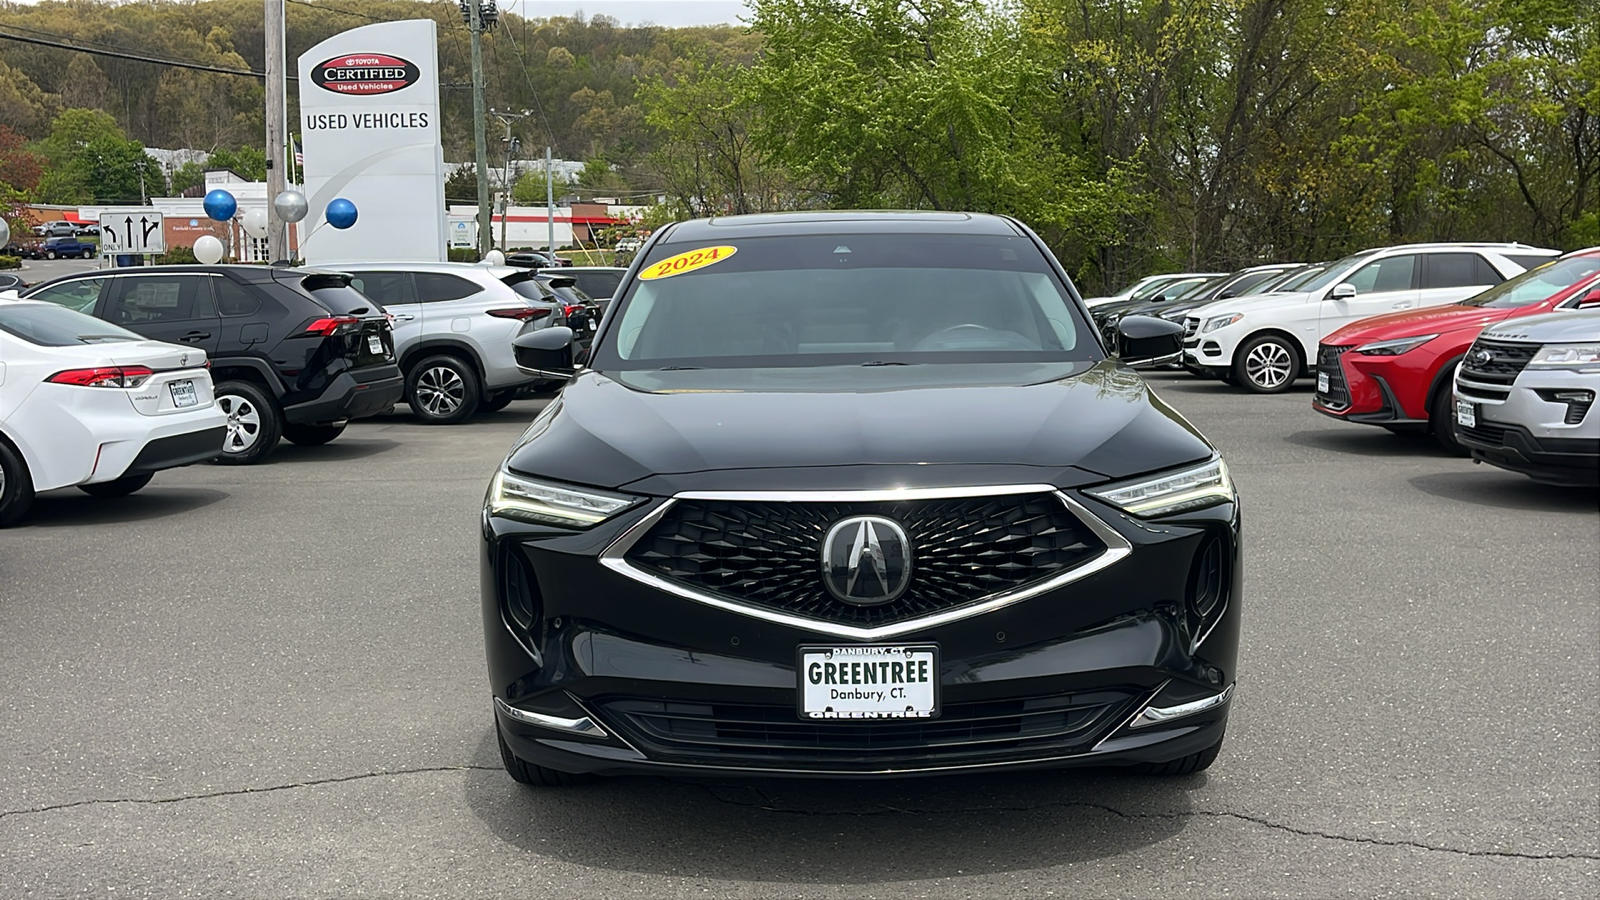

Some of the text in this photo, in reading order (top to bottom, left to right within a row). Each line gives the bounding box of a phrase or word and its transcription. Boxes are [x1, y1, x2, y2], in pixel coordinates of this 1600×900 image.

[337, 83, 358, 91] Used
[307, 112, 429, 130] USED VEHICLES
[657, 248, 721, 277] 2024
[833, 647, 888, 656] DANBURY,
[808, 660, 928, 685] GREENTREE
[830, 687, 907, 702] Danbury, CT.
[809, 710, 931, 719] GREENTREE
